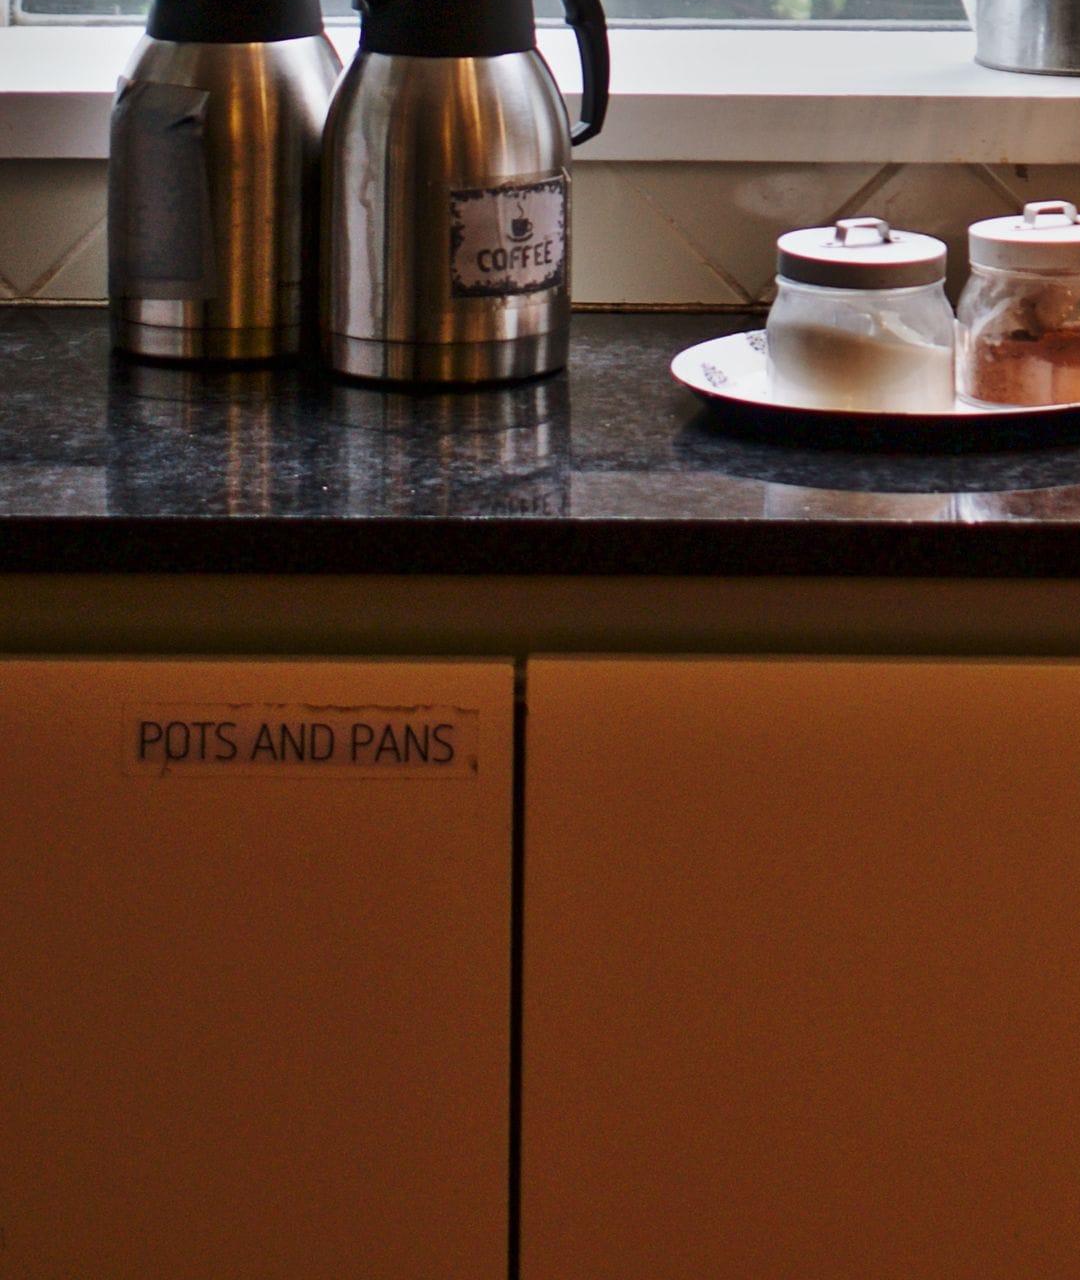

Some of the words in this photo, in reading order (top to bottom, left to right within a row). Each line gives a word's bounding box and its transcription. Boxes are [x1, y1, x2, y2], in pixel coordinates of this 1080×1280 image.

[478, 240, 553, 272] COFFEE
[139, 721, 238, 762] POTS
[250, 724, 335, 762] AND
[351, 723, 455, 764] PANS
